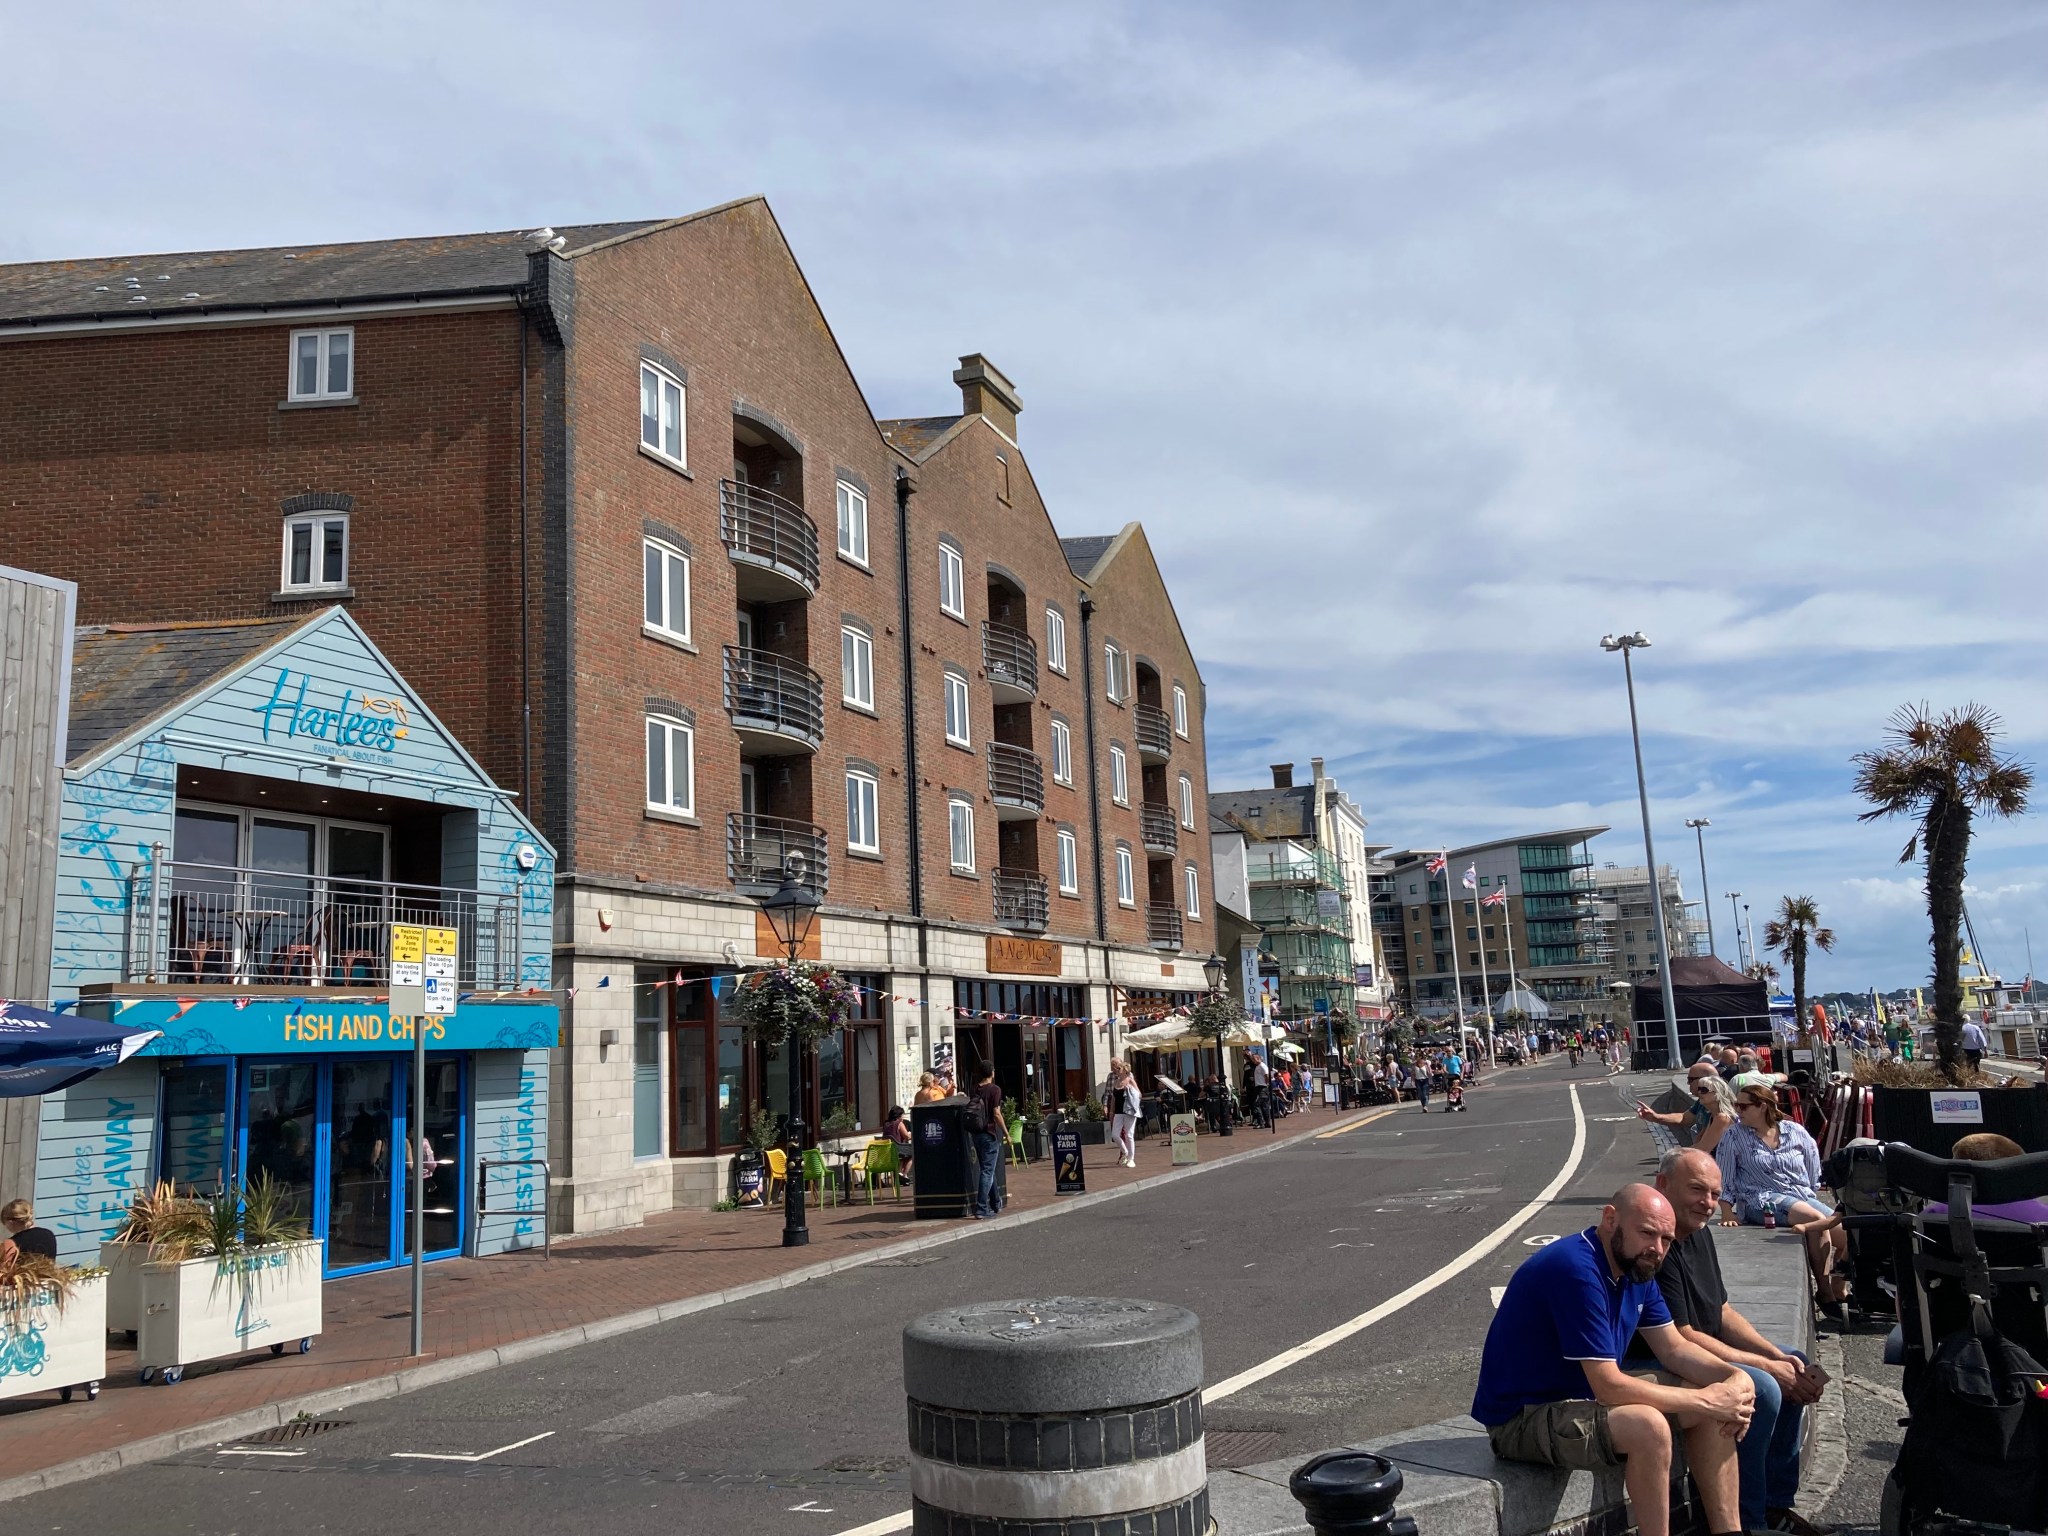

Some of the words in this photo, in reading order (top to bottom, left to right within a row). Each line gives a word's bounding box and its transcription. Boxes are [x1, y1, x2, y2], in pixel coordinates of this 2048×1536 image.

[252, 667, 395, 751] Harlees
[313, 744, 349, 757] FANATICAL
[352, 751, 376, 762] ABOUT
[377, 755, 393, 765] FISH
[284, 1014, 333, 1041] FISH
[338, 1014, 382, 1040] AND
[388, 1015, 445, 1040] CHPS
[490, 1115, 511, 1188] Harlees
[516, 1066, 535, 1235] RESTAURANT
[57, 1145, 93, 1241] Harlees
